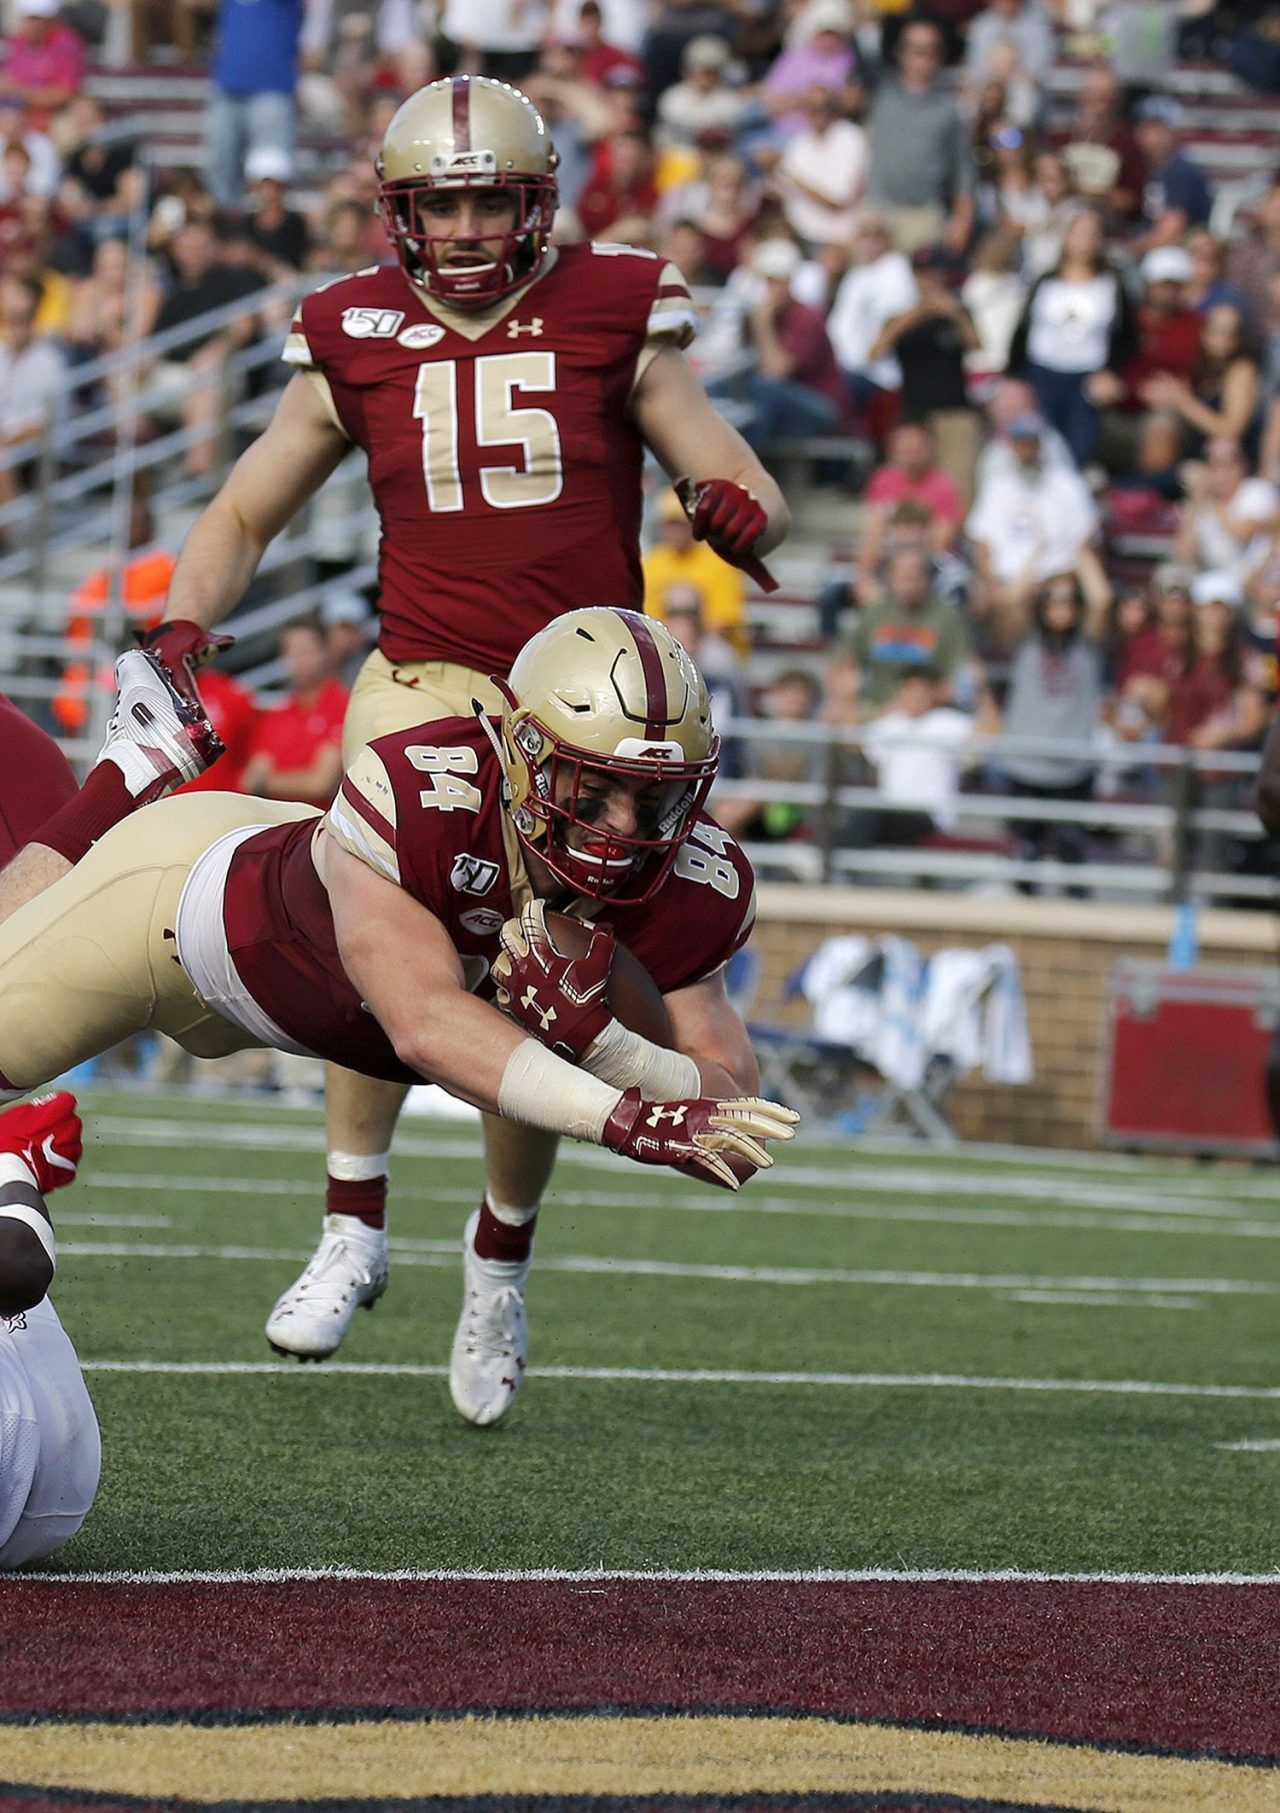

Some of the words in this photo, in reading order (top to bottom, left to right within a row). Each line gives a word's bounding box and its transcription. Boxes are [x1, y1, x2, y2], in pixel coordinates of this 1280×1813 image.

[341, 307, 405, 338] 150
[413, 351, 563, 512] 15
[638, 747, 673, 759] ACC
[404, 744, 482, 812] 84
[674, 820, 739, 899] 84
[465, 912, 502, 928] ACC
